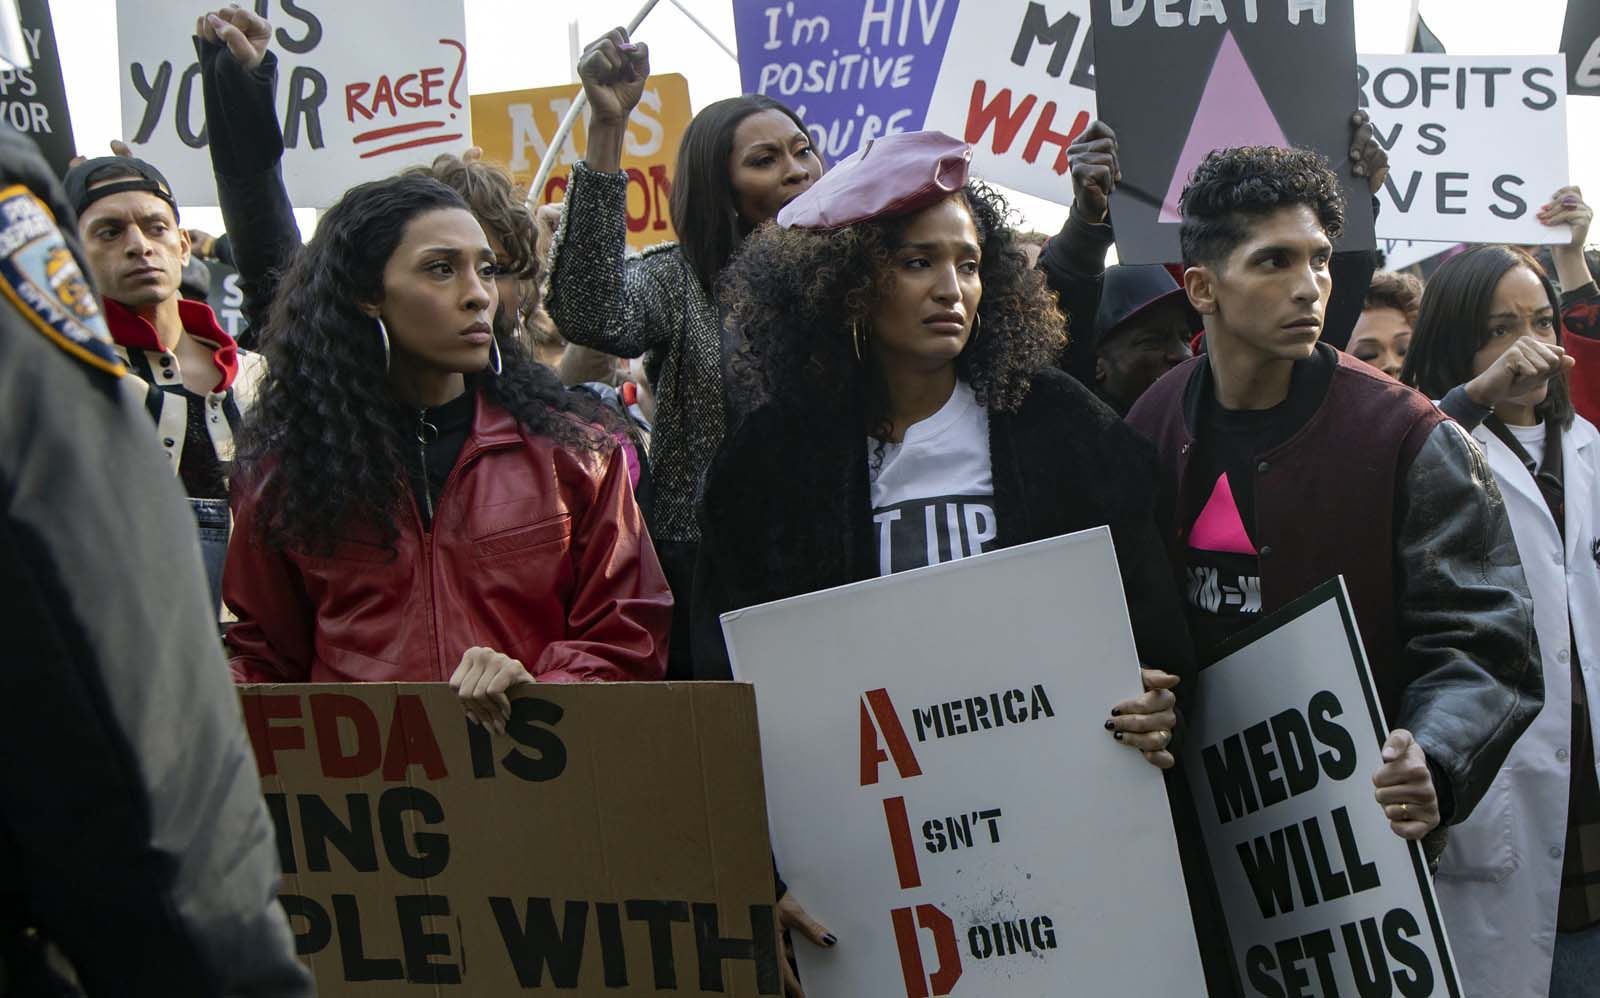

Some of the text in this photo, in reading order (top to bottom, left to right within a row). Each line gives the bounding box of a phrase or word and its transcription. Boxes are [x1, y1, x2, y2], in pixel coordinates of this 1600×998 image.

[763, 0, 945, 50] I'm HIV
[130, 38, 466, 149] YOR RAGE?
[797, 103, 913, 158] OU'RE
[1370, 122, 1447, 156] VS
[244, 694, 567, 782] FDA IS
[859, 683, 1055, 786] AMERICA
[1201, 689, 1358, 824] MEDS
[882, 795, 1002, 889] ISN'T
[1235, 805, 1381, 919] WILL
[488, 895, 781, 995] WITH
[890, 903, 1058, 998] DOING
[1245, 907, 1435, 998] SET US
